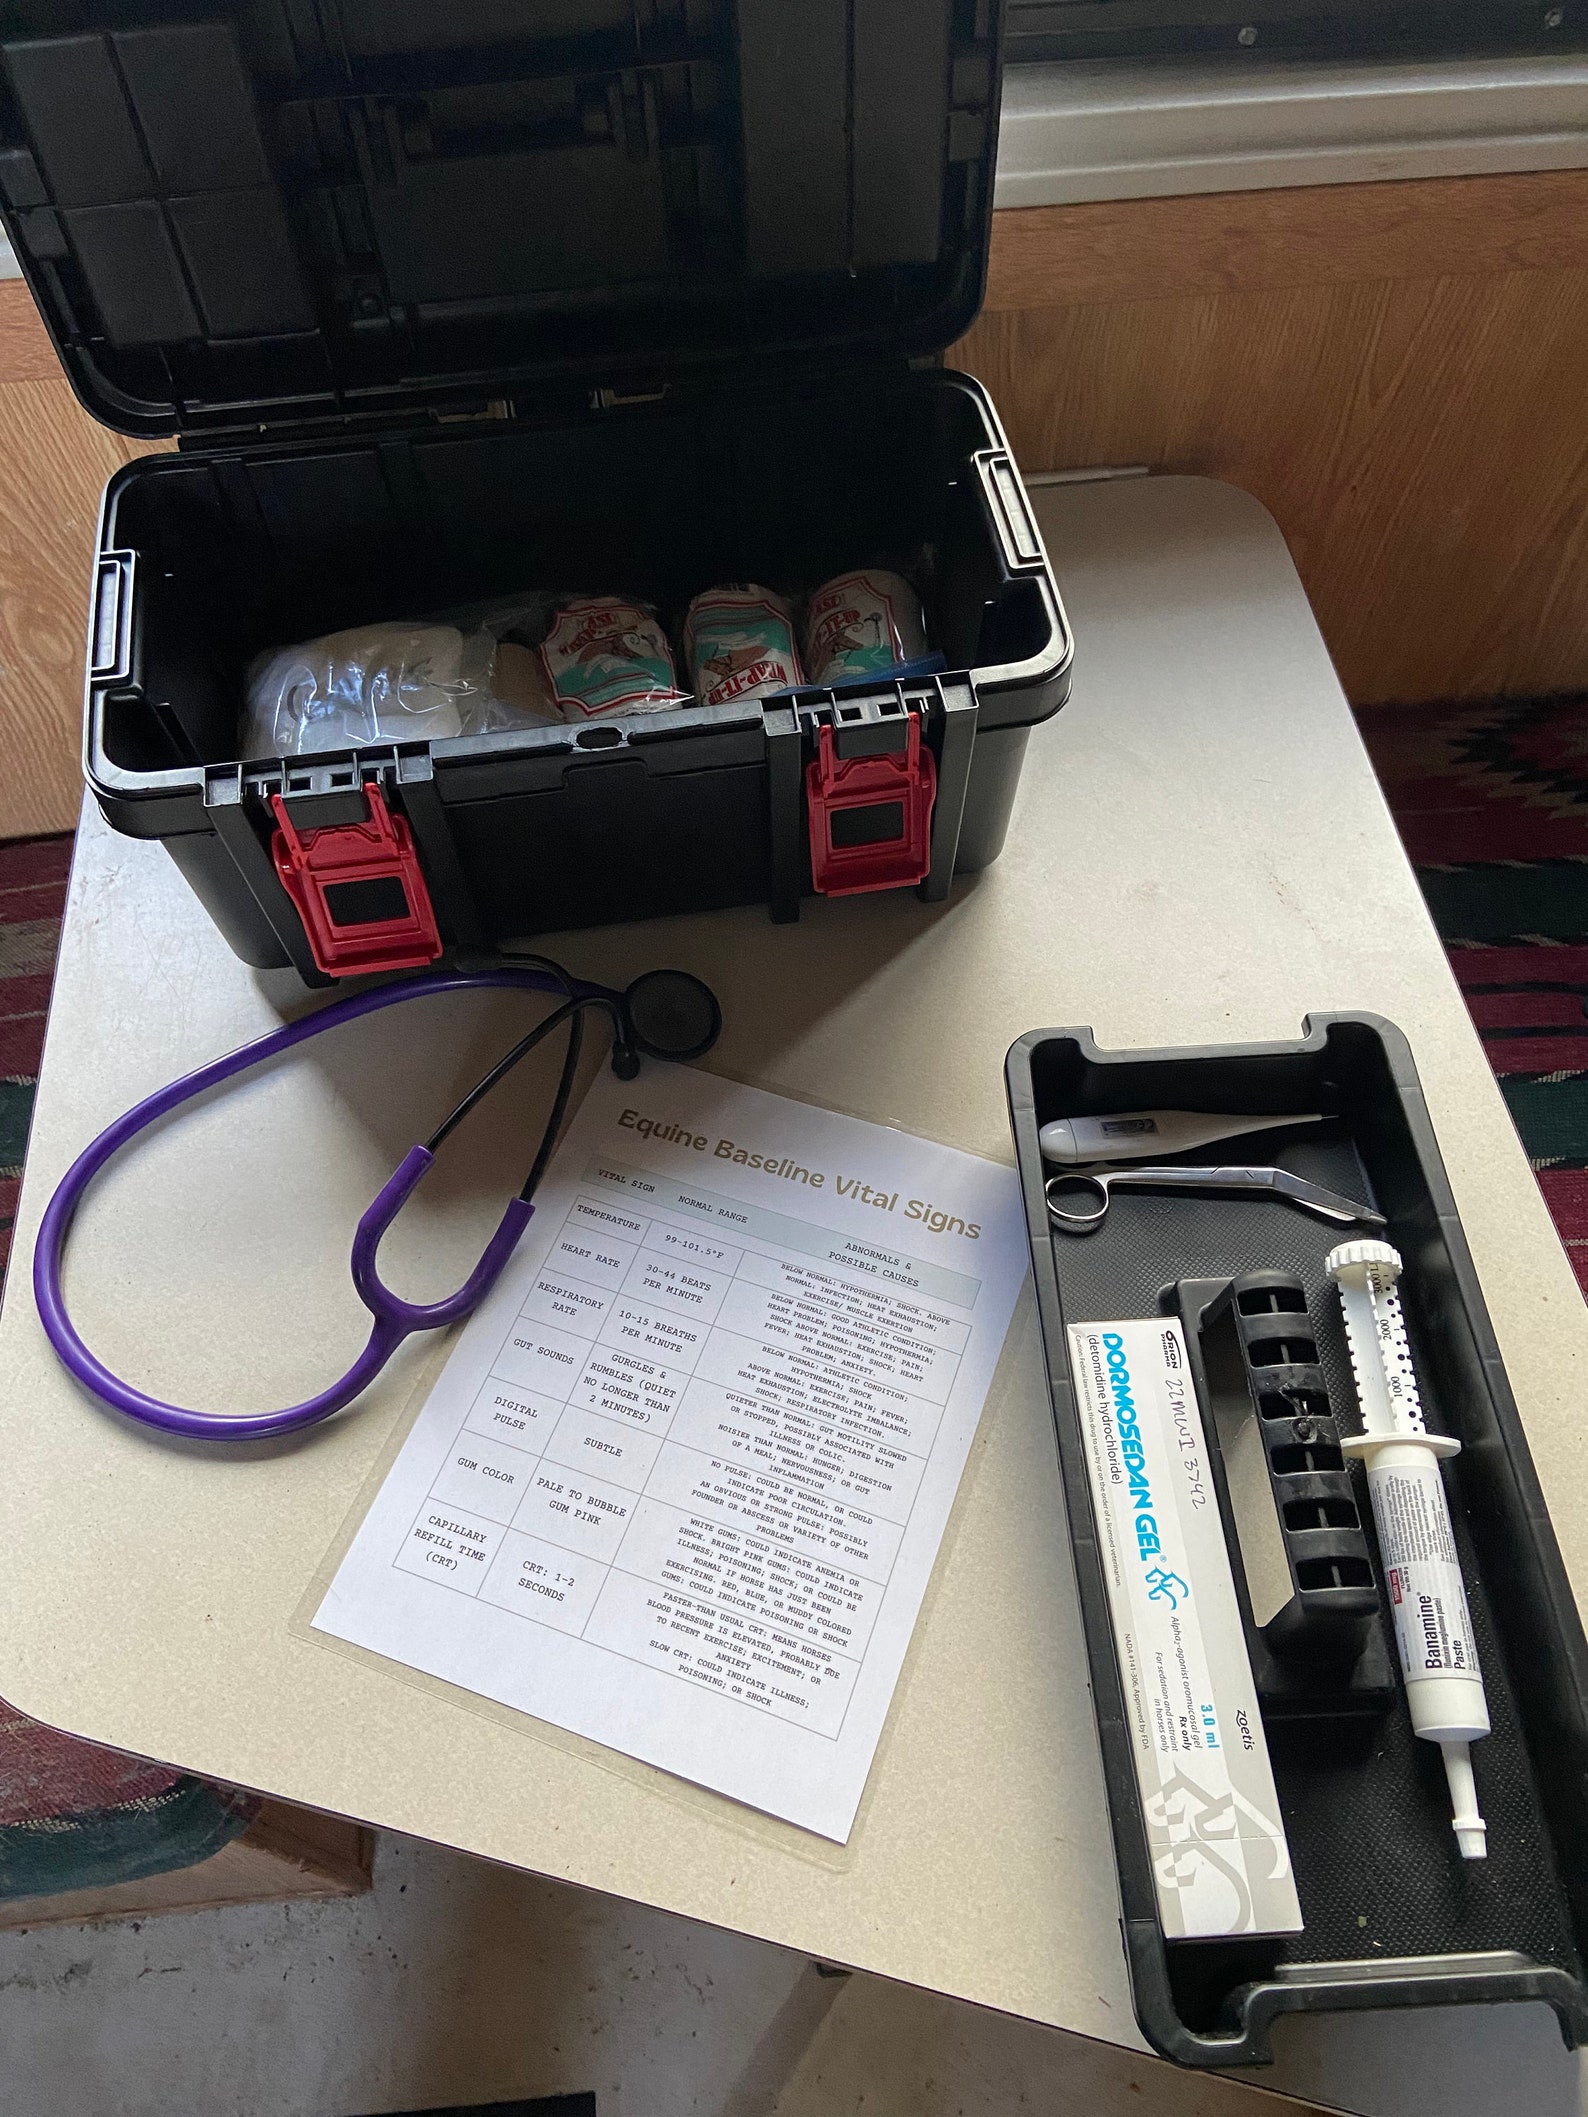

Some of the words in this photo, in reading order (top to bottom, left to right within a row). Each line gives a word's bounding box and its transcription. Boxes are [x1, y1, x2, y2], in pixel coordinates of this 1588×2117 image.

[597, 1168, 626, 1184] VITAL
[630, 1179, 655, 1193] SIGN
[617, 1108, 708, 1152] Equine
[713, 1139, 825, 1188] Baseline
[835, 1175, 899, 1212] Vital
[904, 1199, 982, 1240] Signs
[576, 1203, 641, 1231] TEMPERATURE
[677, 1194, 713, 1212] NORMAL
[717, 1207, 748, 1223] RANGE
[559, 1241, 592, 1258] HEART
[594, 1253, 621, 1268] RATE
[827, 1250, 878, 1273] POSSIBLE
[881, 1268, 919, 1287] CAUSES
[843, 1241, 900, 1266] ABNORMALS
[904, 1261, 911, 1270] &
[641, 1276, 662, 1290] PER
[664, 1284, 703, 1304] MINUTE
[645, 1263, 676, 1280] 30-44
[679, 1274, 712, 1291] BEATS
[536, 1280, 604, 1310] RESPIRATORY
[550, 1300, 577, 1316] RATE
[779, 1262, 804, 1275] BELOW
[925, 1312, 951, 1326] ABOVE
[866, 1301, 886, 1313] HEAT
[618, 1309, 649, 1326] 10-15
[652, 1321, 697, 1342] BREATHS
[620, 1325, 641, 1338] PER
[643, 1333, 683, 1353] MINUTE
[1380, 1319, 1392, 1341] 2000
[512, 1337, 533, 1350] GUT
[536, 1345, 574, 1365] SOUNDS
[1159, 1333, 1171, 1367] PHARMA
[610, 1353, 655, 1375] GURGLES
[658, 1370, 667, 1379] &
[760, 1345, 786, 1358] BELOW
[821, 1366, 860, 1384] ATHLETIC
[589, 1361, 634, 1383] RUMBLES
[638, 1378, 677, 1398] (QUIET
[847, 1386, 872, 1400] SHOCK
[1390, 1376, 1403, 1398] 1000
[493, 1395, 538, 1418] DIGITAL
[582, 1375, 597, 1386] NO
[600, 1381, 639, 1402] LONGER
[643, 1396, 671, 1413] THAN
[588, 1393, 596, 1403] 2
[600, 1397, 651, 1423] MINUTES)
[492, 1411, 526, 1430] PULSE
[1085, 1333, 1106, 1399] (detomidine
[1096, 1400, 1123, 1484] hydrochloride)
[1101, 1332, 1153, 1509] DORMOSEDAN
[725, 1391, 758, 1408] QUIETER
[760, 1403, 781, 1416] THAN
[818, 1424, 834, 1435] GUT
[835, 1430, 875, 1450] MOTILITY
[877, 1446, 907, 1462] SLOWED
[729, 1404, 741, 1413] OR
[782, 1423, 822, 1442] POSSIBLY
[823, 1437, 871, 1460] ASSOCIATED
[874, 1456, 895, 1469] WITH
[768, 1429, 802, 1446] ILLNESS
[804, 1442, 815, 1451] OR
[582, 1436, 623, 1457] SUBTLE
[456, 1456, 478, 1471] GUM
[481, 1465, 515, 1484] COLOR
[768, 1463, 825, 1490] INFLAMMATION
[535, 1476, 564, 1494] PALE
[567, 1488, 583, 1500] TO
[585, 1495, 627, 1517] BUBBLE
[726, 1477, 765, 1496] INDICATE
[766, 1492, 788, 1505] POOR
[548, 1499, 570, 1514] GUM
[573, 1508, 601, 1525] PINK
[698, 1479, 711, 1488] AN
[712, 1484, 747, 1502] OBVIOUS
[749, 1497, 761, 1507] OR
[763, 1502, 793, 1519] STRONG
[828, 1526, 868, 1547] POSSIBLY
[427, 1514, 487, 1543] CAPILLARY
[755, 1523, 795, 1544] PROBLEMS
[413, 1527, 453, 1550] REFILL
[457, 1544, 486, 1562] TIME
[425, 1550, 458, 1571] (CRT)
[521, 1559, 548, 1576] CRT:
[554, 1572, 575, 1587] 1-2
[517, 1576, 565, 1602] SECONDS
[691, 1556, 722, 1573] NORMAL
[725, 1568, 737, 1577] IF
[738, 1573, 765, 1589] HORSE
[767, 1584, 784, 1596] HAS
[785, 1591, 808, 1605] JUST
[810, 1600, 832, 1615] BEEN
[718, 1612, 744, 1628] USUAL
[770, 1632, 798, 1649] MEANS
[800, 1644, 832, 1662] HORSES
[1123, 1632, 1134, 1654] NADA
[648, 1639, 671, 1652] SLOW
[696, 1657, 723, 1673] COULD
[725, 1668, 767, 1691] INDICATE
[714, 1651, 752, 1671] ANXIETY
[1154, 1650, 1163, 1665] For
[1451, 1639, 1466, 1670] Paste
[730, 1684, 743, 1695] OR
[744, 1690, 772, 1707] SHOCK
[1156, 1665, 1169, 1700] sedation
[1132, 1688, 1146, 1723] Approved
[1153, 1697, 1161, 1707] in
[1162, 1699, 1174, 1717] and
[1181, 1680, 1201, 1733] oromucosal
[1199, 1703, 1216, 1726] 3.0
[1137, 1723, 1146, 1734] by
[1154, 1706, 1166, 1734] horses
[1178, 1715, 1188, 1728] Rx
[1234, 1708, 1255, 1751] zoetis
[1140, 1733, 1150, 1750] FDA
[1159, 1733, 1170, 1753] only
[1166, 1717, 1179, 1752] restraint
[1180, 1729, 1192, 1751] only
[1189, 1733, 1203, 1749] gel
[1204, 1731, 1220, 1748] ml
